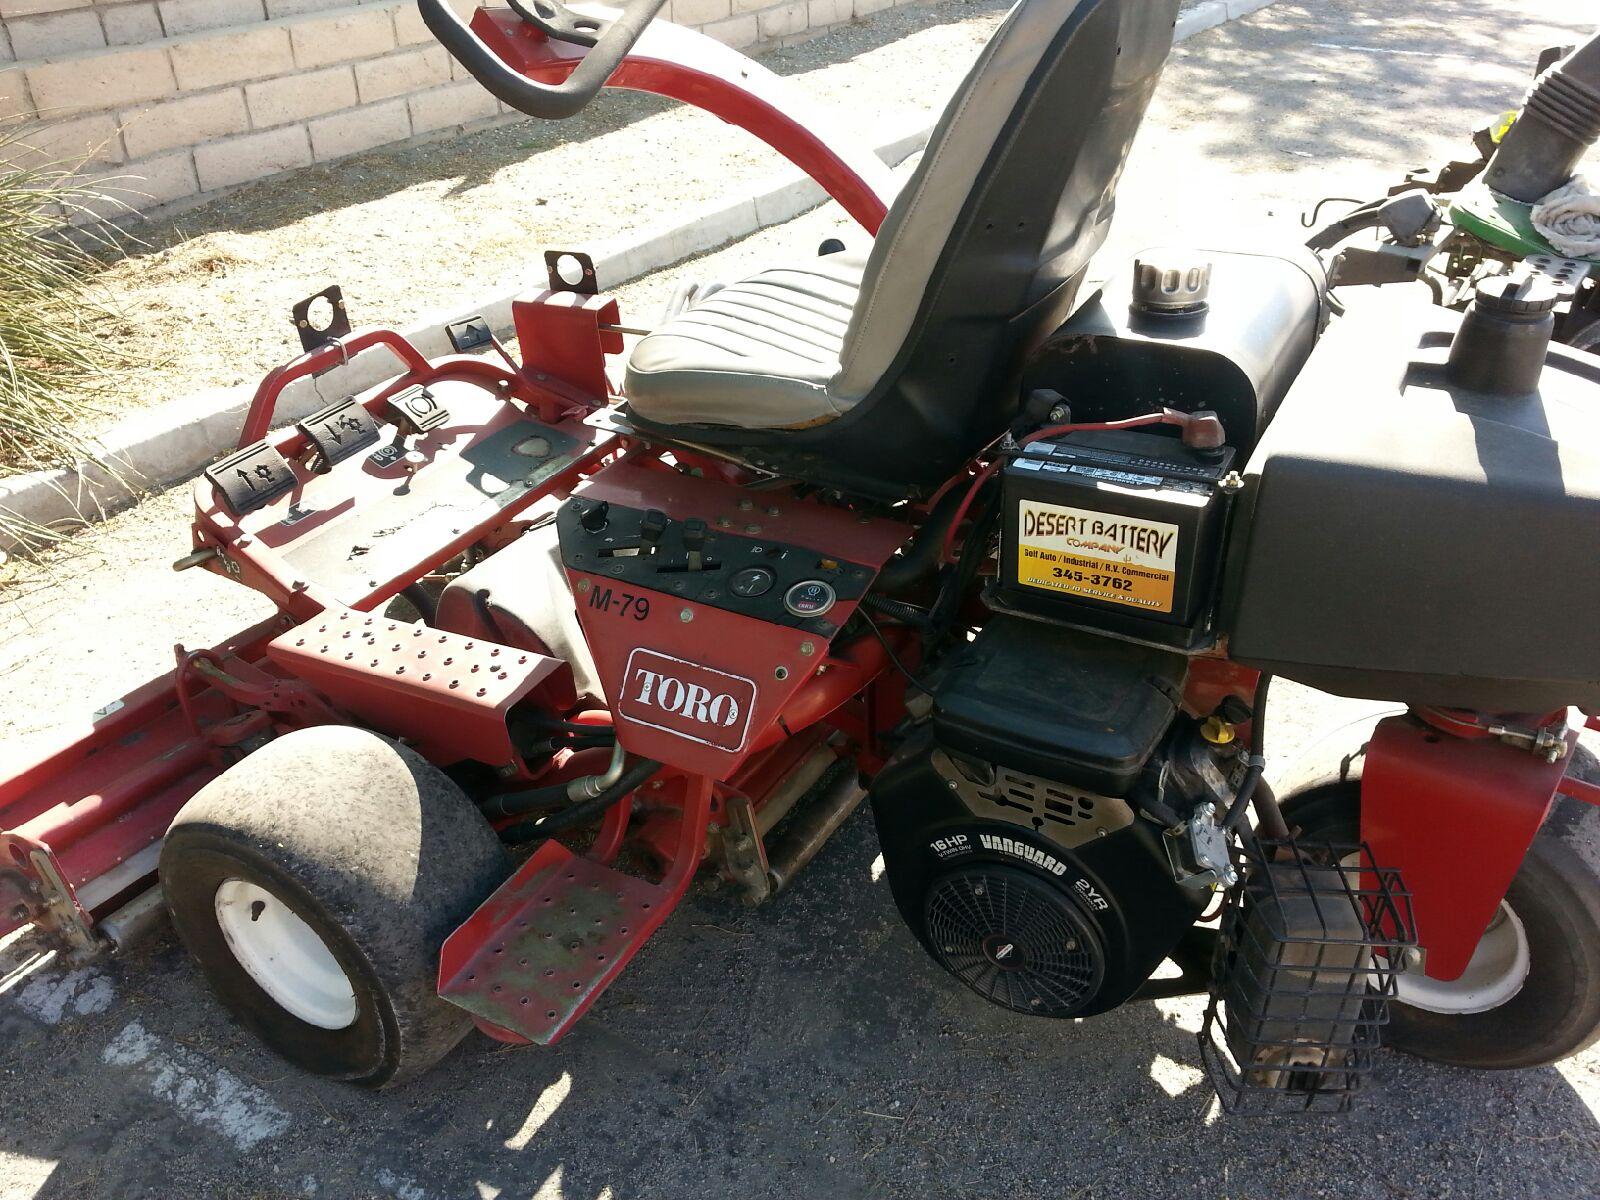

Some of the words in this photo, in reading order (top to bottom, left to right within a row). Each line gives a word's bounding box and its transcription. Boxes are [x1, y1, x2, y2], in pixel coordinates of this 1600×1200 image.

[1024, 509, 1087, 537] DESERT
[1091, 520, 1174, 558] BATTERY
[1066, 537, 1126, 554] COMPANY
[1040, 551, 1057, 562] Auto
[1063, 555, 1099, 569] Industrial
[1105, 563, 1120, 574] R.V.
[1122, 566, 1170, 581] Commercial
[1052, 567, 1133, 592] 345-3762
[589, 584, 650, 621] M-79
[1082, 587, 1116, 599] SERVICE
[1125, 595, 1163, 607] QUALITY
[635, 668, 739, 728] TORO
[979, 834, 1068, 876] VANGUARD
